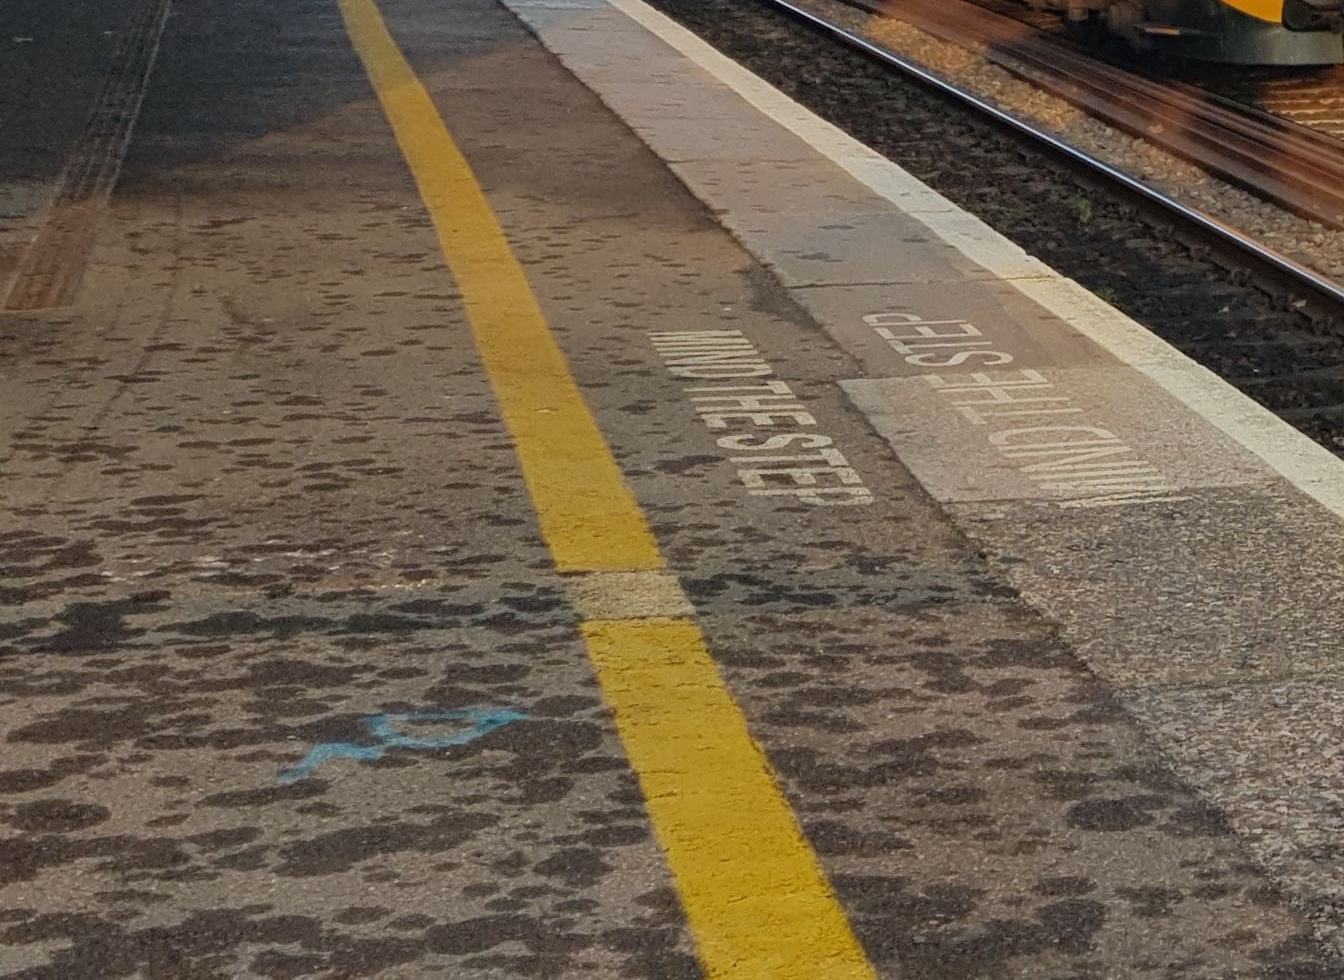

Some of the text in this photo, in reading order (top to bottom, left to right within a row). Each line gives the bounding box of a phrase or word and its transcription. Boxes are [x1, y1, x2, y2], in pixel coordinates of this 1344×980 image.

[646, 329, 875, 506] MIND THE STEP
[862, 312, 1193, 509] MIND THE STEP
